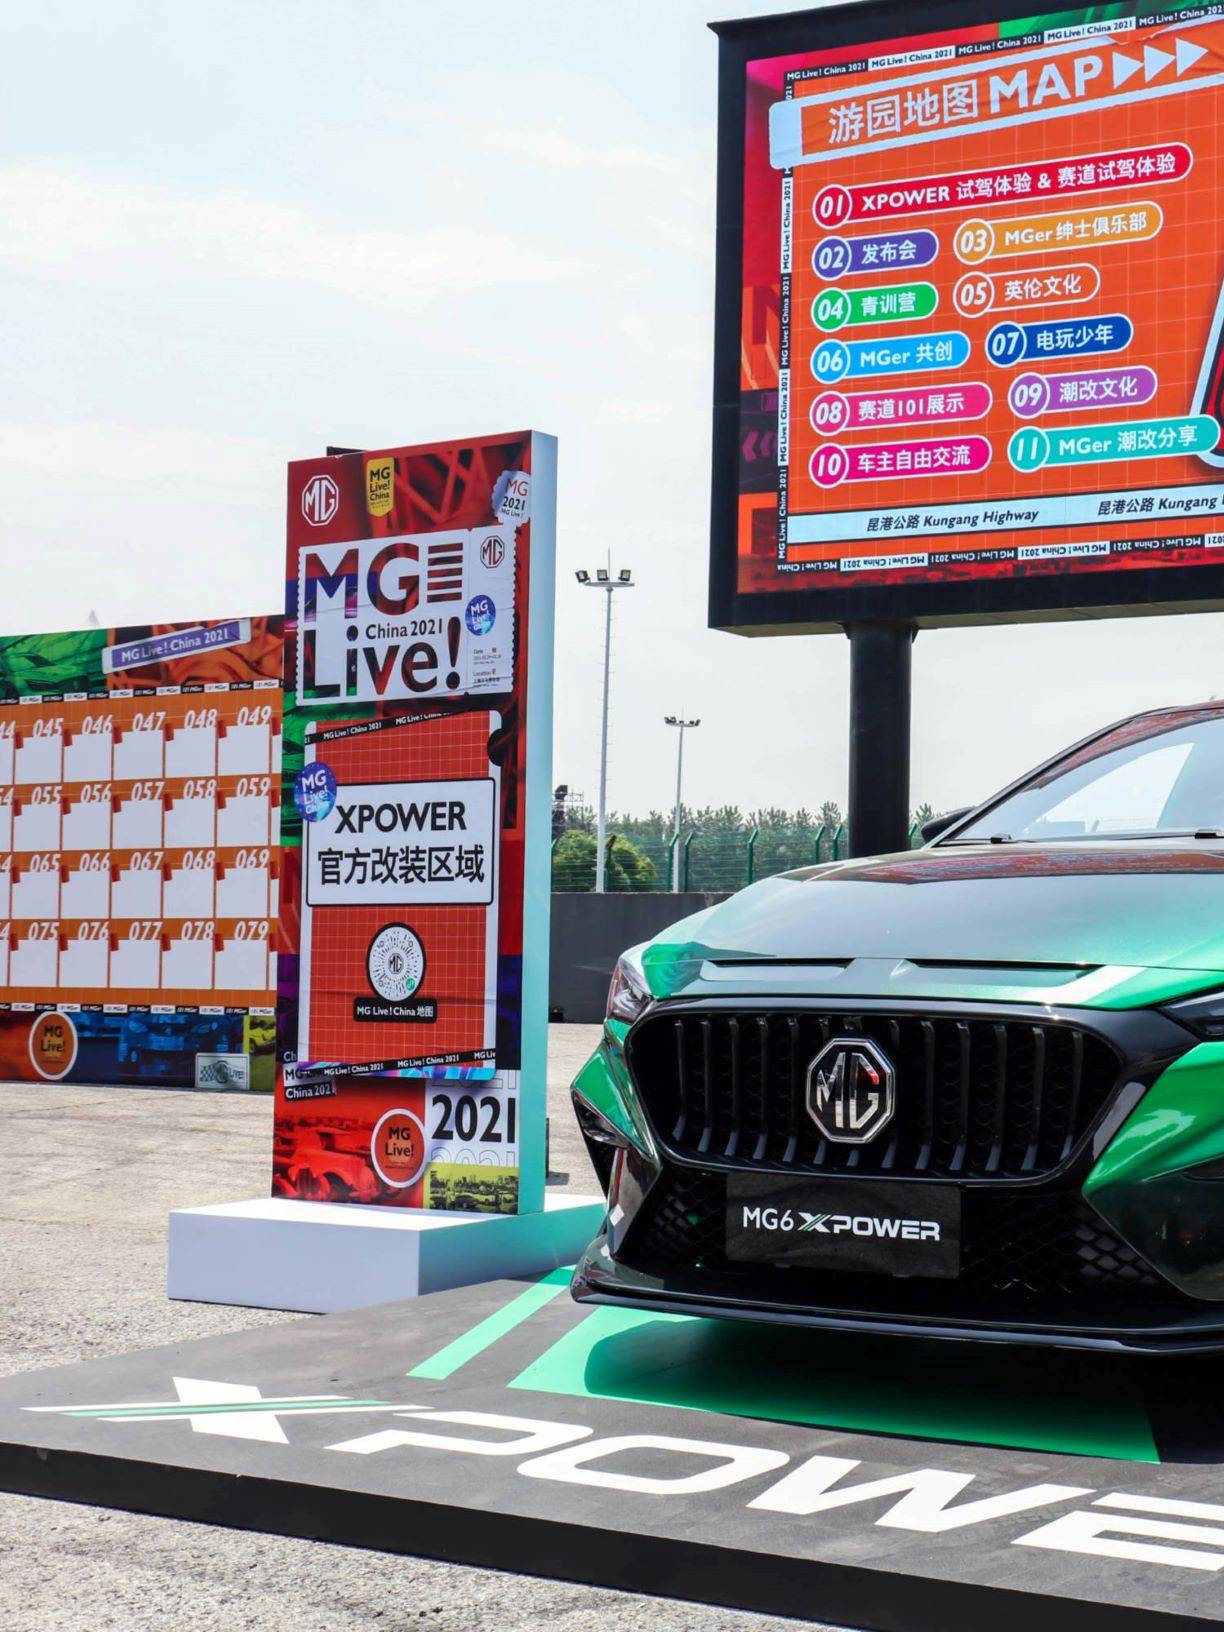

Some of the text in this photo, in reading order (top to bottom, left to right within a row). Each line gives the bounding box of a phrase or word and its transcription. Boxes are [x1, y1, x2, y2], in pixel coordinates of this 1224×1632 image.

[828, 55, 1103, 144] 游园地图 MAP
[820, 152, 1176, 218] 01 XPOWER 试驾体验 & 赛道试驾体验
[960, 211, 1147, 254] 03 MGer 绅士俱乐部
[819, 240, 917, 270] 02 发布会
[960, 273, 1081, 306] 05 英伦文化
[818, 292, 916, 321] 04 青训营
[992, 324, 1114, 356] 07 电玩少年
[816, 340, 953, 374] 06 MGer 共创
[1014, 376, 1137, 408] 09 潮改文化
[816, 393, 964, 425] 08 赛道101展示
[1016, 425, 1198, 461] 11 MGer 潮改分享
[370, 466, 390, 482] MG
[817, 445, 970, 477] 10 车主自由交流
[303, 477, 338, 524] MG
[505, 478, 528, 496] MG
[502, 496, 525, 511] 2021
[1098, 497, 1154, 516] 昆港公路
[1158, 494, 1218, 511] Kungang
[867, 508, 1039, 533] 昆港公路 Kungang Highway
[481, 537, 504, 567] MG
[304, 543, 420, 622] MG
[366, 618, 443, 641] China 2021
[121, 629, 229, 663] MG Live! China 2021
[303, 616, 461, 699] Live!
[33, 706, 272, 737] 045 046 047 048 049
[323, 731, 334, 740] MG
[31, 777, 271, 805] 055 056 057 058 059
[302, 769, 326, 791] MG
[335, 801, 466, 834] XPOWER
[30, 849, 270, 873] 065 066 067 068 069
[318, 844, 485, 886] 官方改装区域
[28, 921, 269, 941] 075 076 077 078 079
[357, 1006, 370, 1015] MG
[393, 1006, 415, 1016] China
[417, 1006, 434, 1017] 地图
[44, 1026, 63, 1037] MG
[285, 1087, 313, 1099] China
[811, 1044, 888, 1137] MG
[389, 1127, 411, 1140] MG
[432, 1094, 516, 1144] 2021
[385, 1143, 414, 1158] Live!
[743, 1206, 941, 1242] MG6 XPOWER
